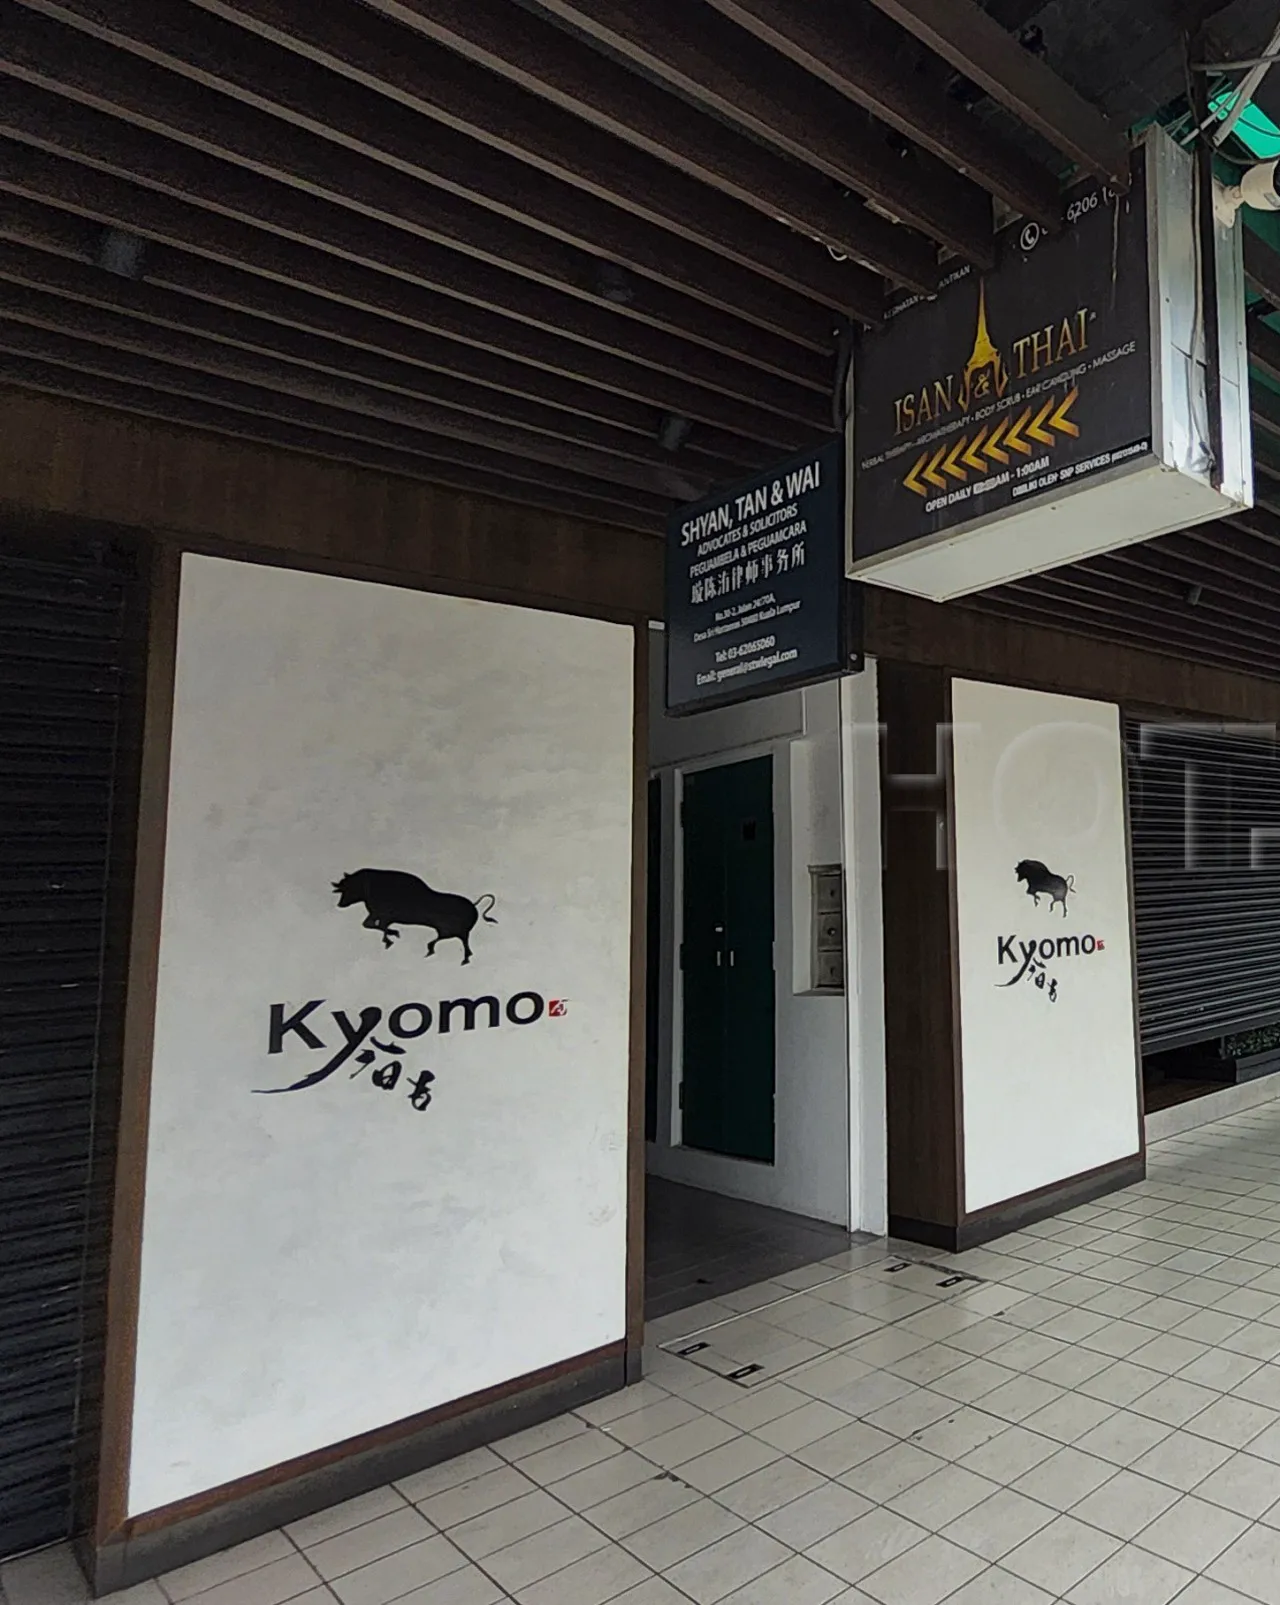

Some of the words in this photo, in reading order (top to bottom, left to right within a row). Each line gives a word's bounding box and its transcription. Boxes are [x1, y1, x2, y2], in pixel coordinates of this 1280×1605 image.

[1067, 191, 1098, 221] 6206
[894, 374, 954, 436] ISAN
[1013, 308, 1088, 379] THAI
[975, 406, 996, 421] BODY
[996, 392, 1021, 412] SCRUB
[1026, 383, 1042, 398] EAR
[1092, 341, 1136, 368] MASSAGE
[925, 495, 948, 512] OPEN
[948, 486, 971, 505] DAILY
[1016, 456, 1050, 479] 1:00AM
[1074, 453, 1111, 475] SERVICES
[681, 503, 733, 547] SHYAN,
[735, 486, 767, 521] TAN
[770, 480, 784, 506] &
[786, 461, 820, 499] WAI
[697, 526, 741, 557] ADVOCATES
[742, 524, 749, 538] &
[749, 503, 798, 535] SOLICITORS
[689, 547, 739, 578] PEGUAMBELA
[740, 544, 747, 558] &
[747, 520, 807, 554] PEGUAMCARA
[759, 608, 776, 622] Kuala
[776, 600, 801, 615] Lumpur
[696, 670, 716, 685] Email:
[715, 650, 727, 663] Tel:
[994, 934, 1096, 988] Kyomo
[251, 990, 546, 1094] Kyomo
